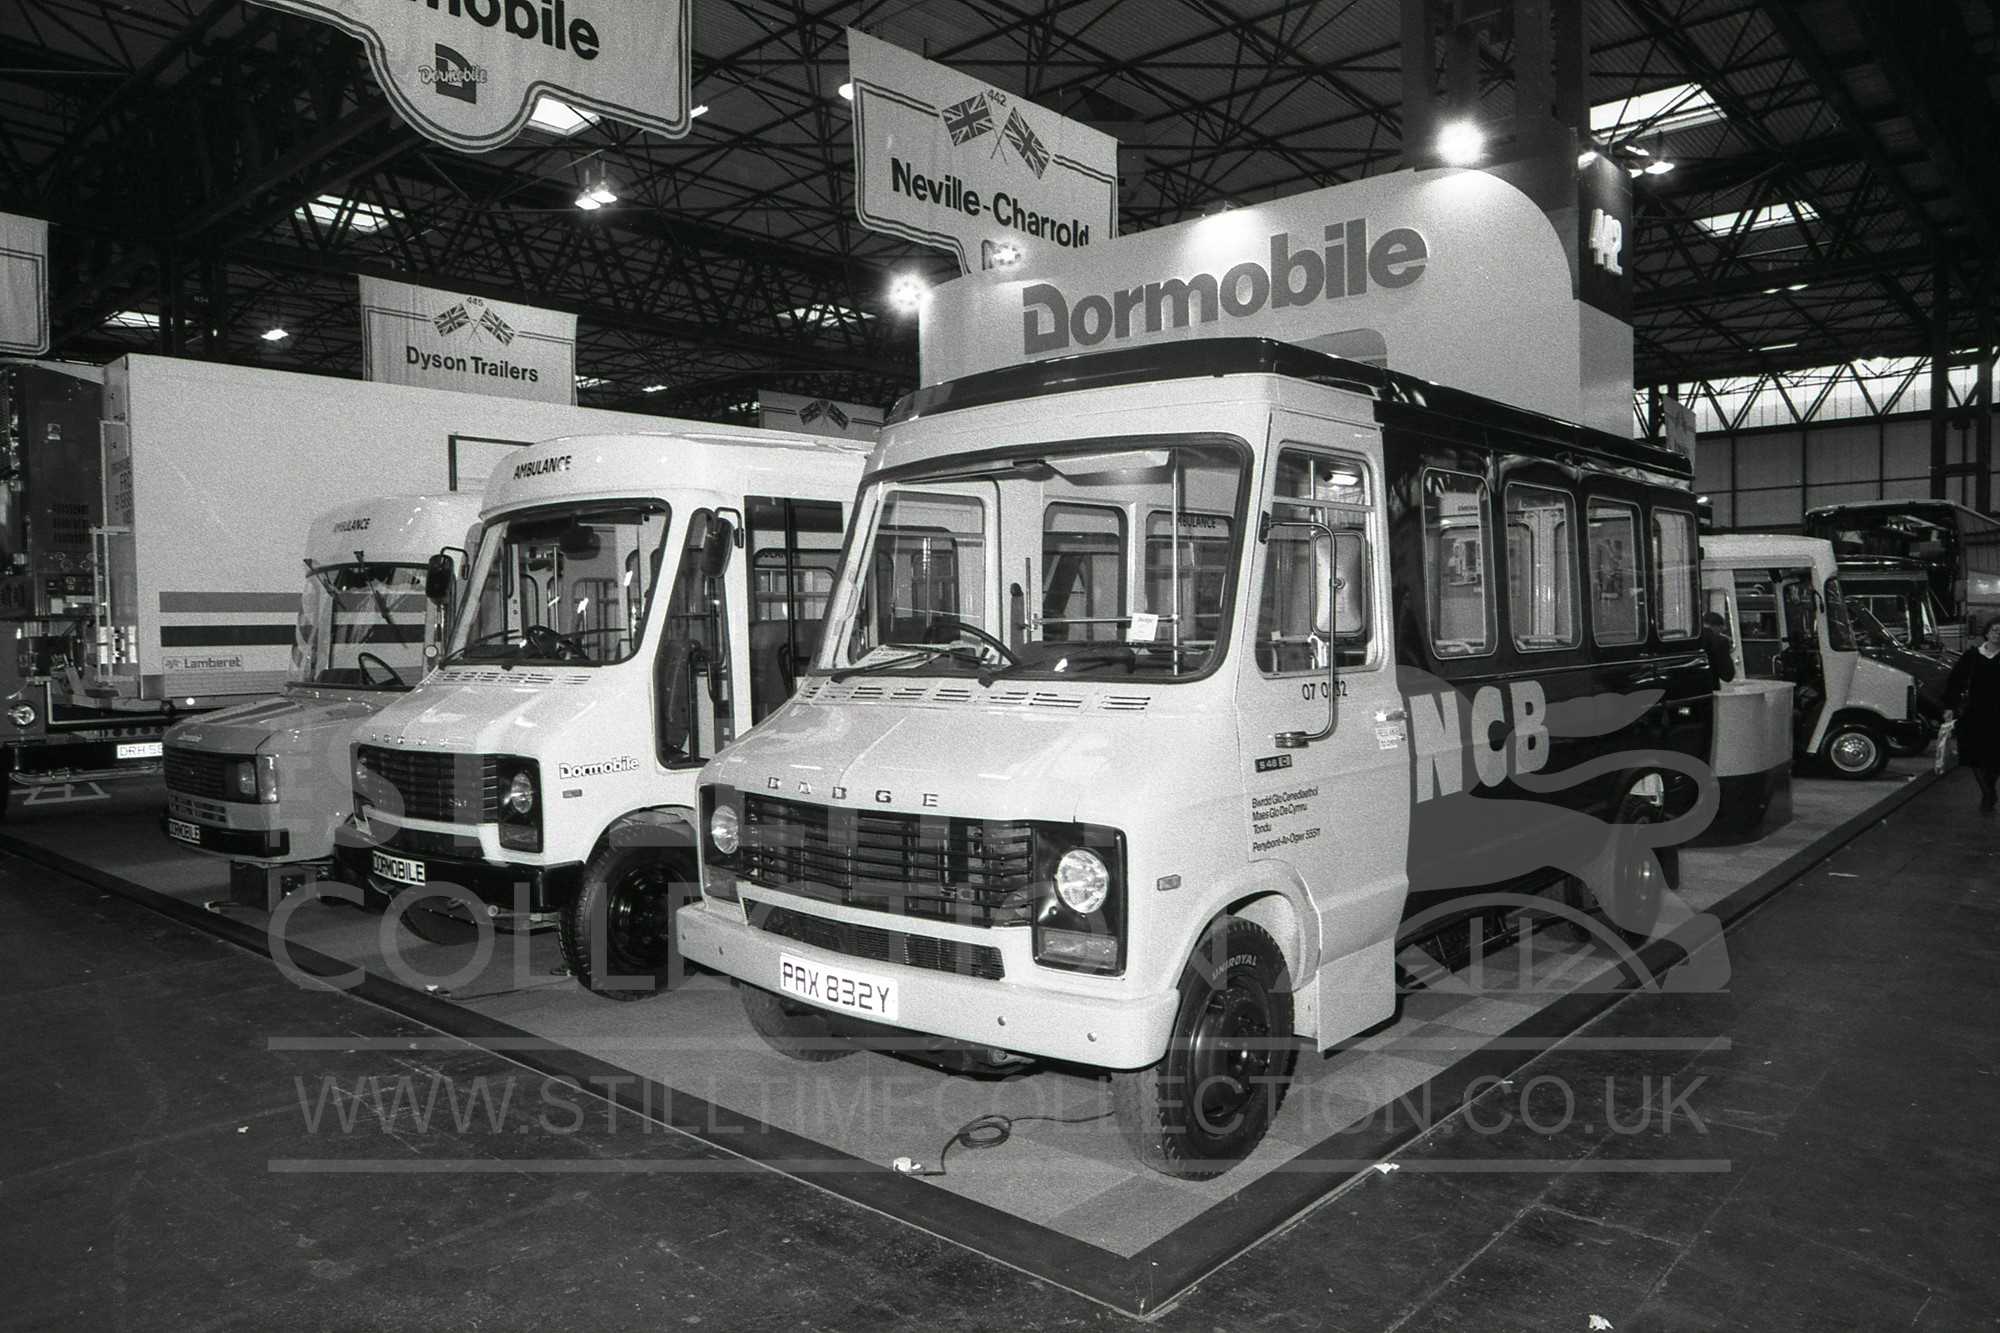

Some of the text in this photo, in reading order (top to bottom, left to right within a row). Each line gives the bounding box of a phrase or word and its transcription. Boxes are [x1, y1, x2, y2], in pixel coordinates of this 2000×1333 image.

[987, 89, 1008, 107] 442
[1022, 218, 1428, 355] Dormobile
[406, 345, 539, 382] Dyson Trailers
[513, 455, 573, 480] AMBULANCE
[184, 657, 241, 669] Lamberet
[1302, 683, 1316, 700] 07
[1409, 680, 1550, 804] NCB
[559, 756, 640, 779] Dormobile
[373, 854, 425, 882] DORMOBILE
[783, 962, 889, 1013] PAX 832Y
